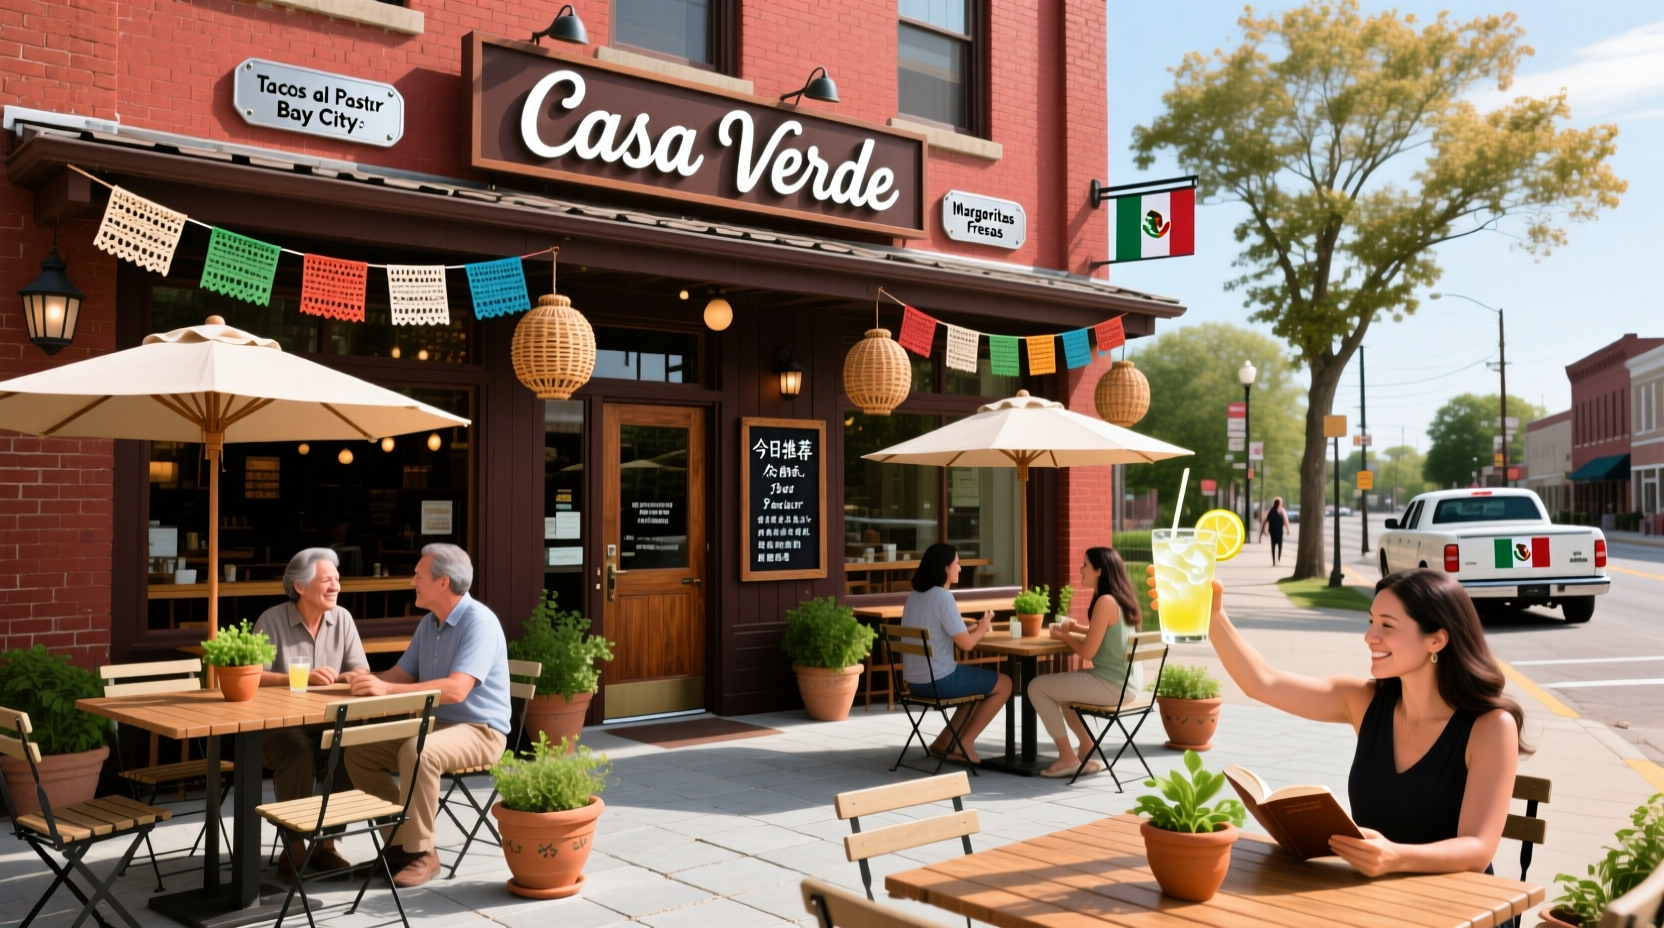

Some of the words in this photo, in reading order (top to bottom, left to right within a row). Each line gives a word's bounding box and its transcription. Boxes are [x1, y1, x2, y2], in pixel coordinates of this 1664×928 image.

[257, 74, 307, 99] Tacos
[313, 86, 329, 103] al
[277, 100, 314, 127] Bay
[520, 70, 704, 177] Casa
[718, 110, 900, 212] Verde
